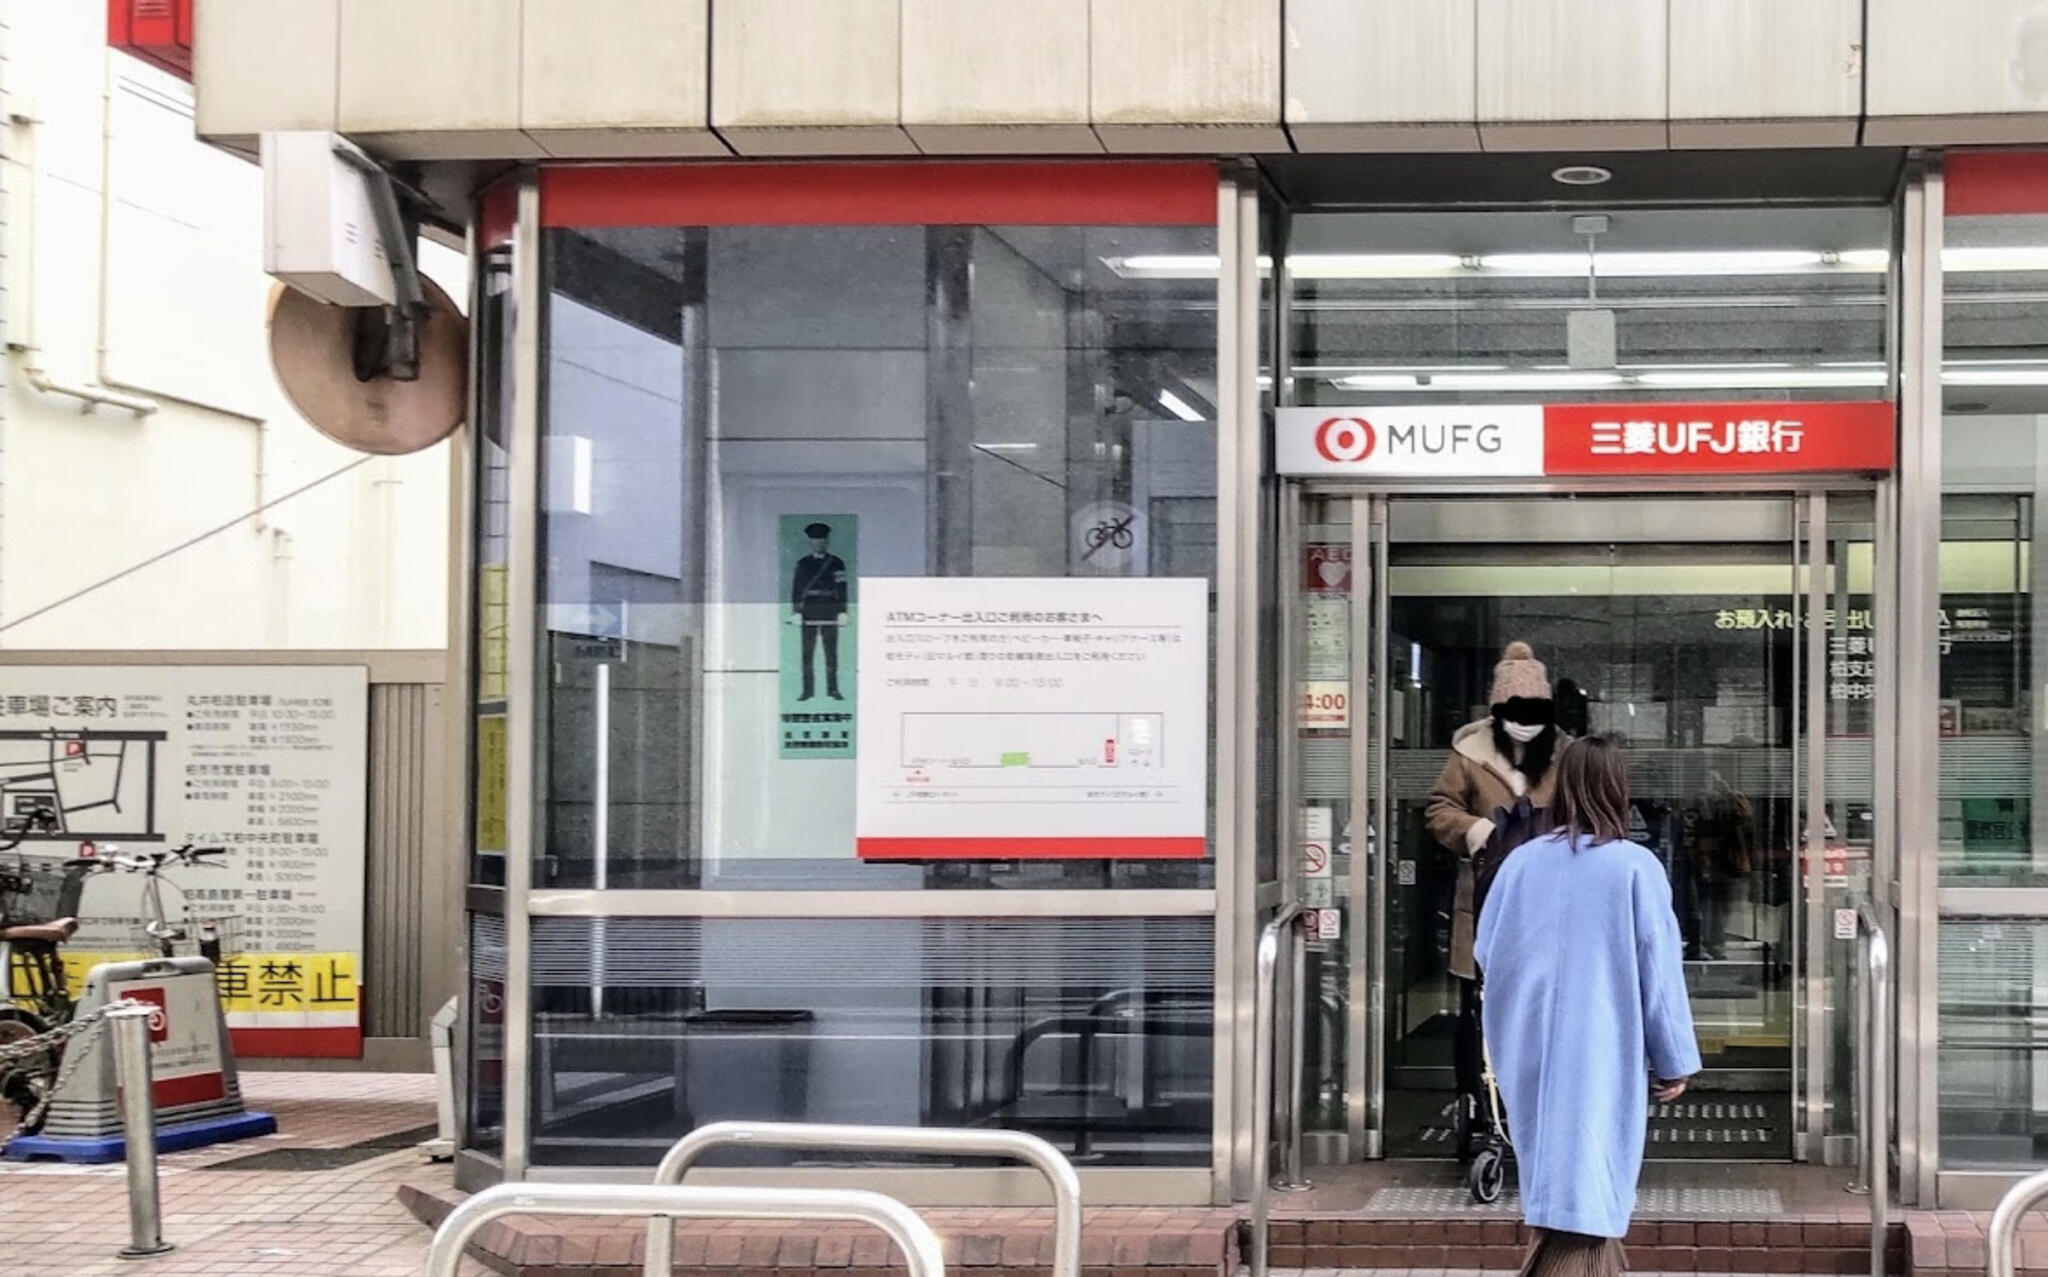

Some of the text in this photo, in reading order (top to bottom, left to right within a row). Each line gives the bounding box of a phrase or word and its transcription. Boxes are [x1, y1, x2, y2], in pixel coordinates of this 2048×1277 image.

[1388, 424, 1502, 454] MUFG
[1590, 421, 1803, 454] 三菱UFJ銀行
